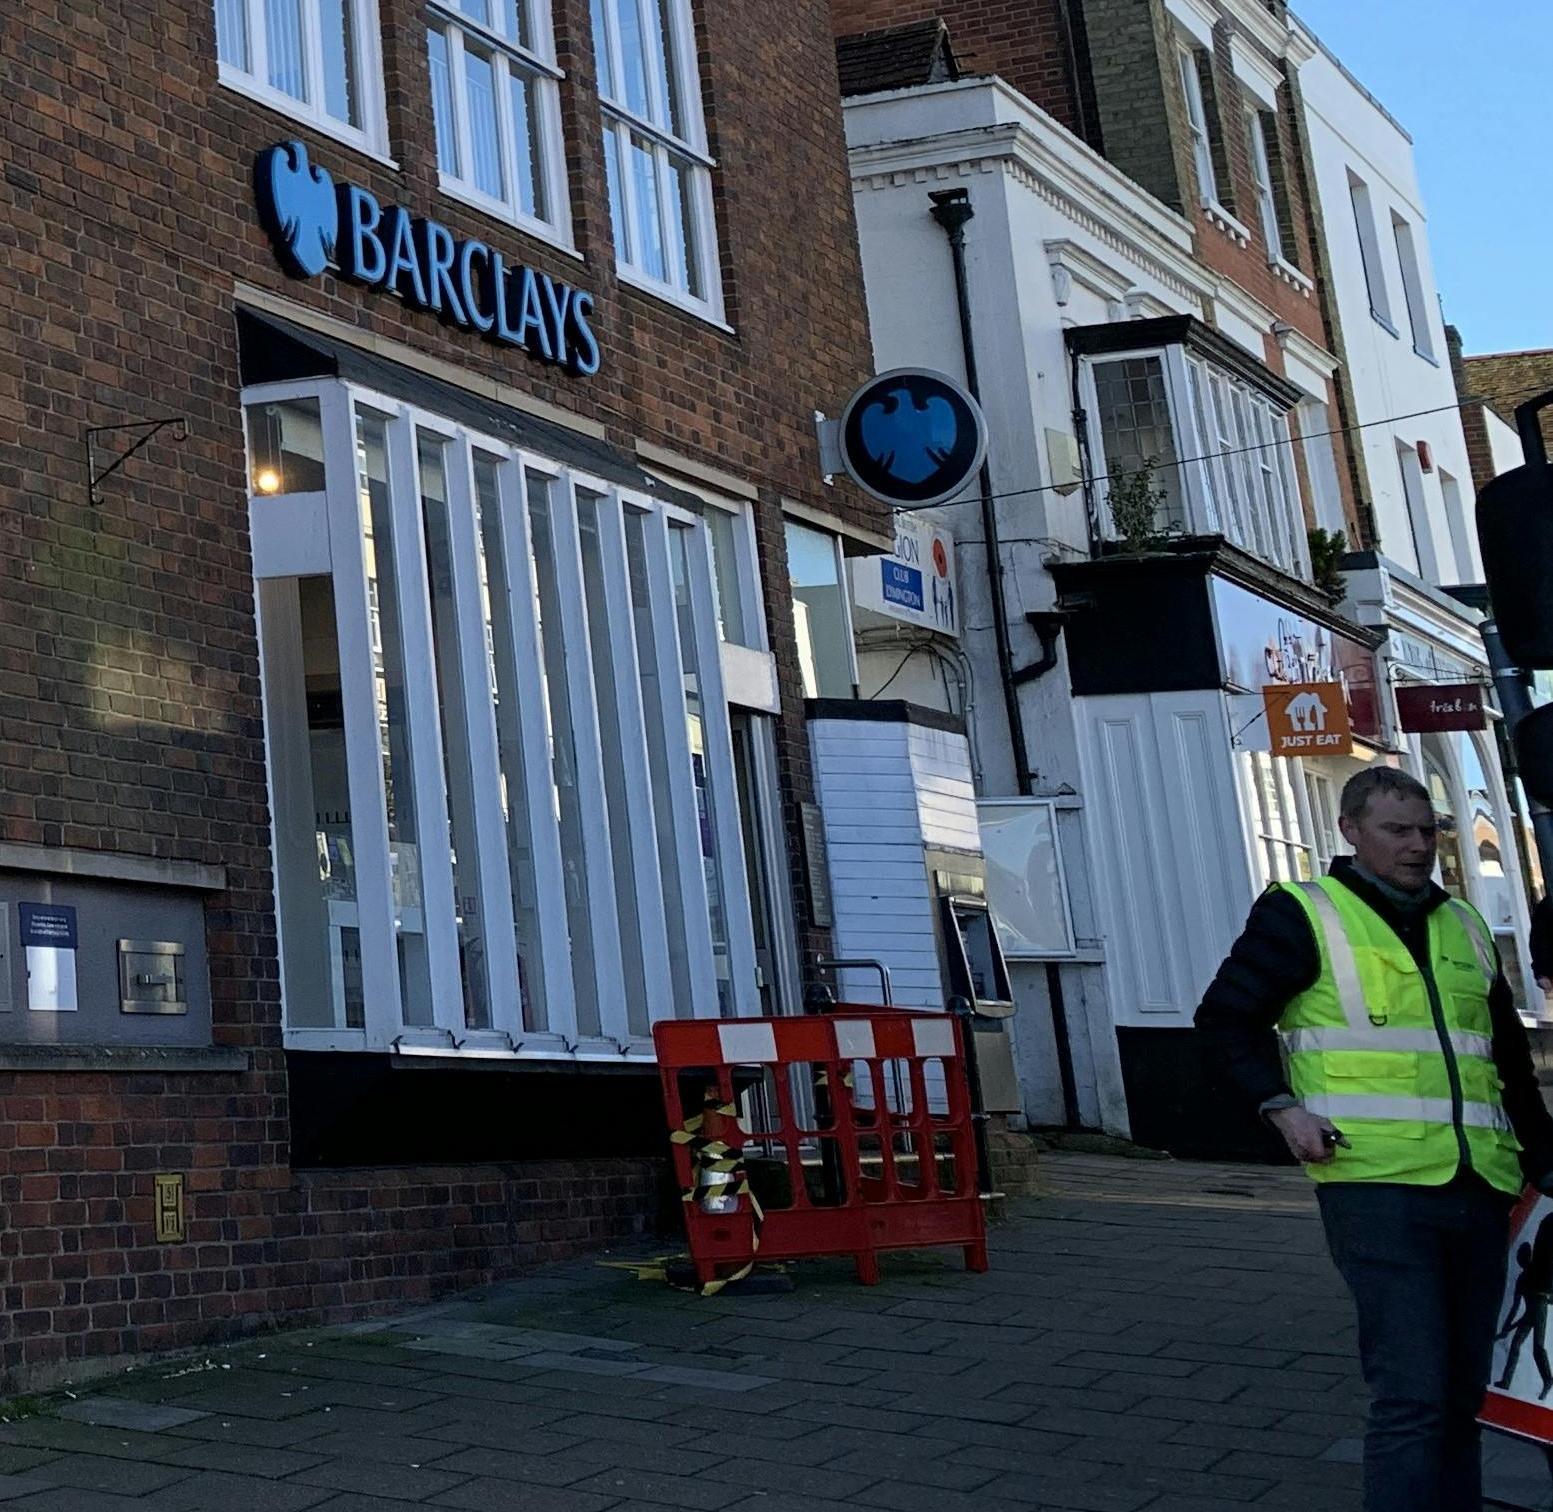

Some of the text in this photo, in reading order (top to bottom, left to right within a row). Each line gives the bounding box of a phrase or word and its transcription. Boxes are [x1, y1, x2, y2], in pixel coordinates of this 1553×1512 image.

[347, 185, 601, 377] BARCLAYS
[1280, 734, 1343, 748] JUST EAT
